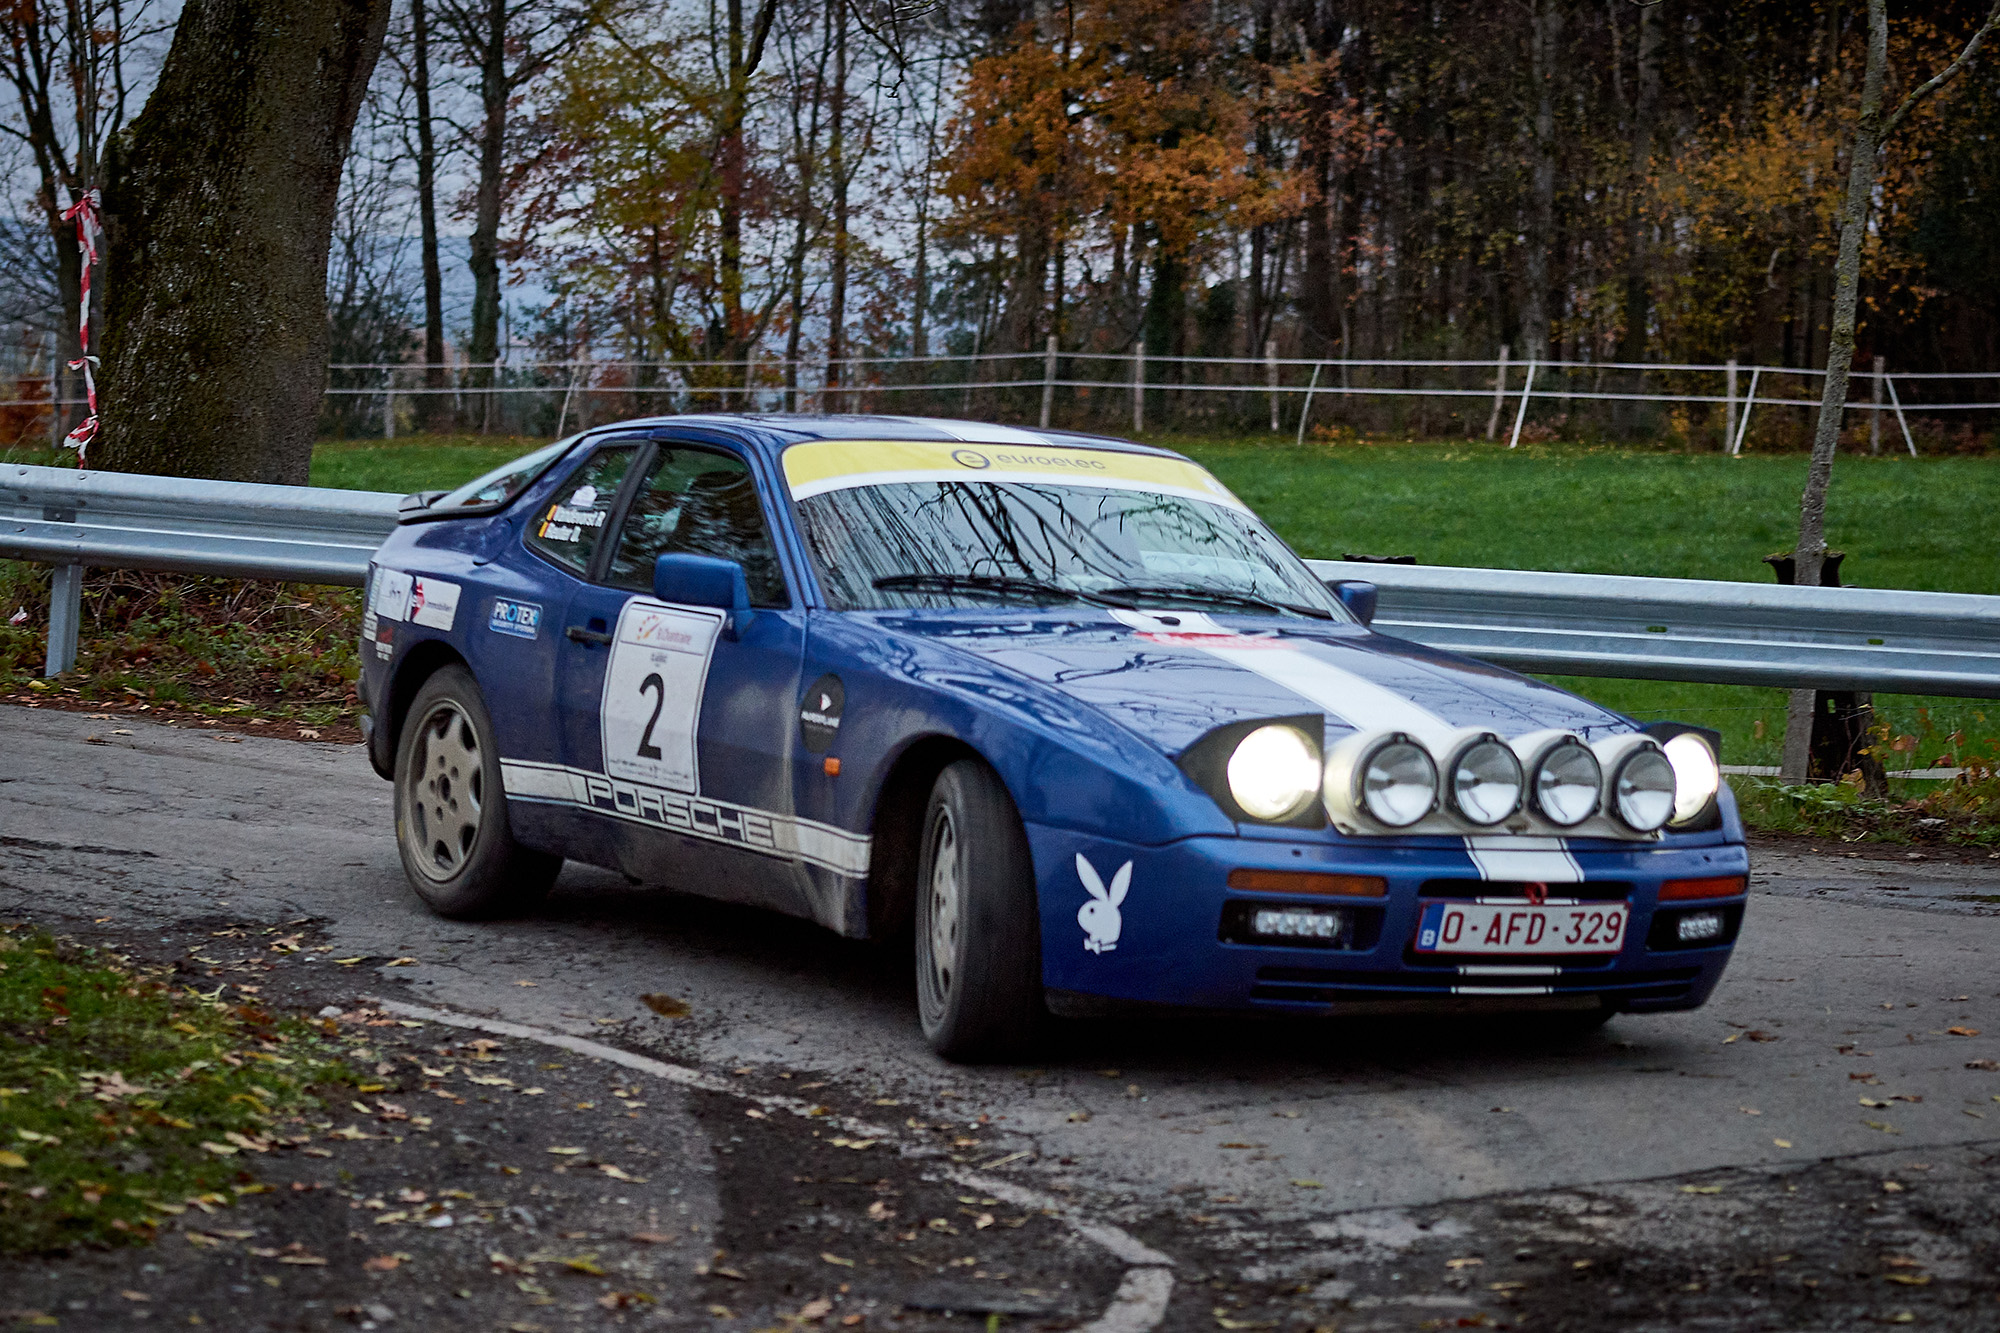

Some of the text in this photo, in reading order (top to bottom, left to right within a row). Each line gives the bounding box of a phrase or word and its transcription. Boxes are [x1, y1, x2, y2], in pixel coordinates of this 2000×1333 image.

[996, 454, 1106, 470] euroelec
[637, 672, 665, 761] 2
[587, 777, 776, 848] PORSCHE
[1420, 929, 1436, 946] B
